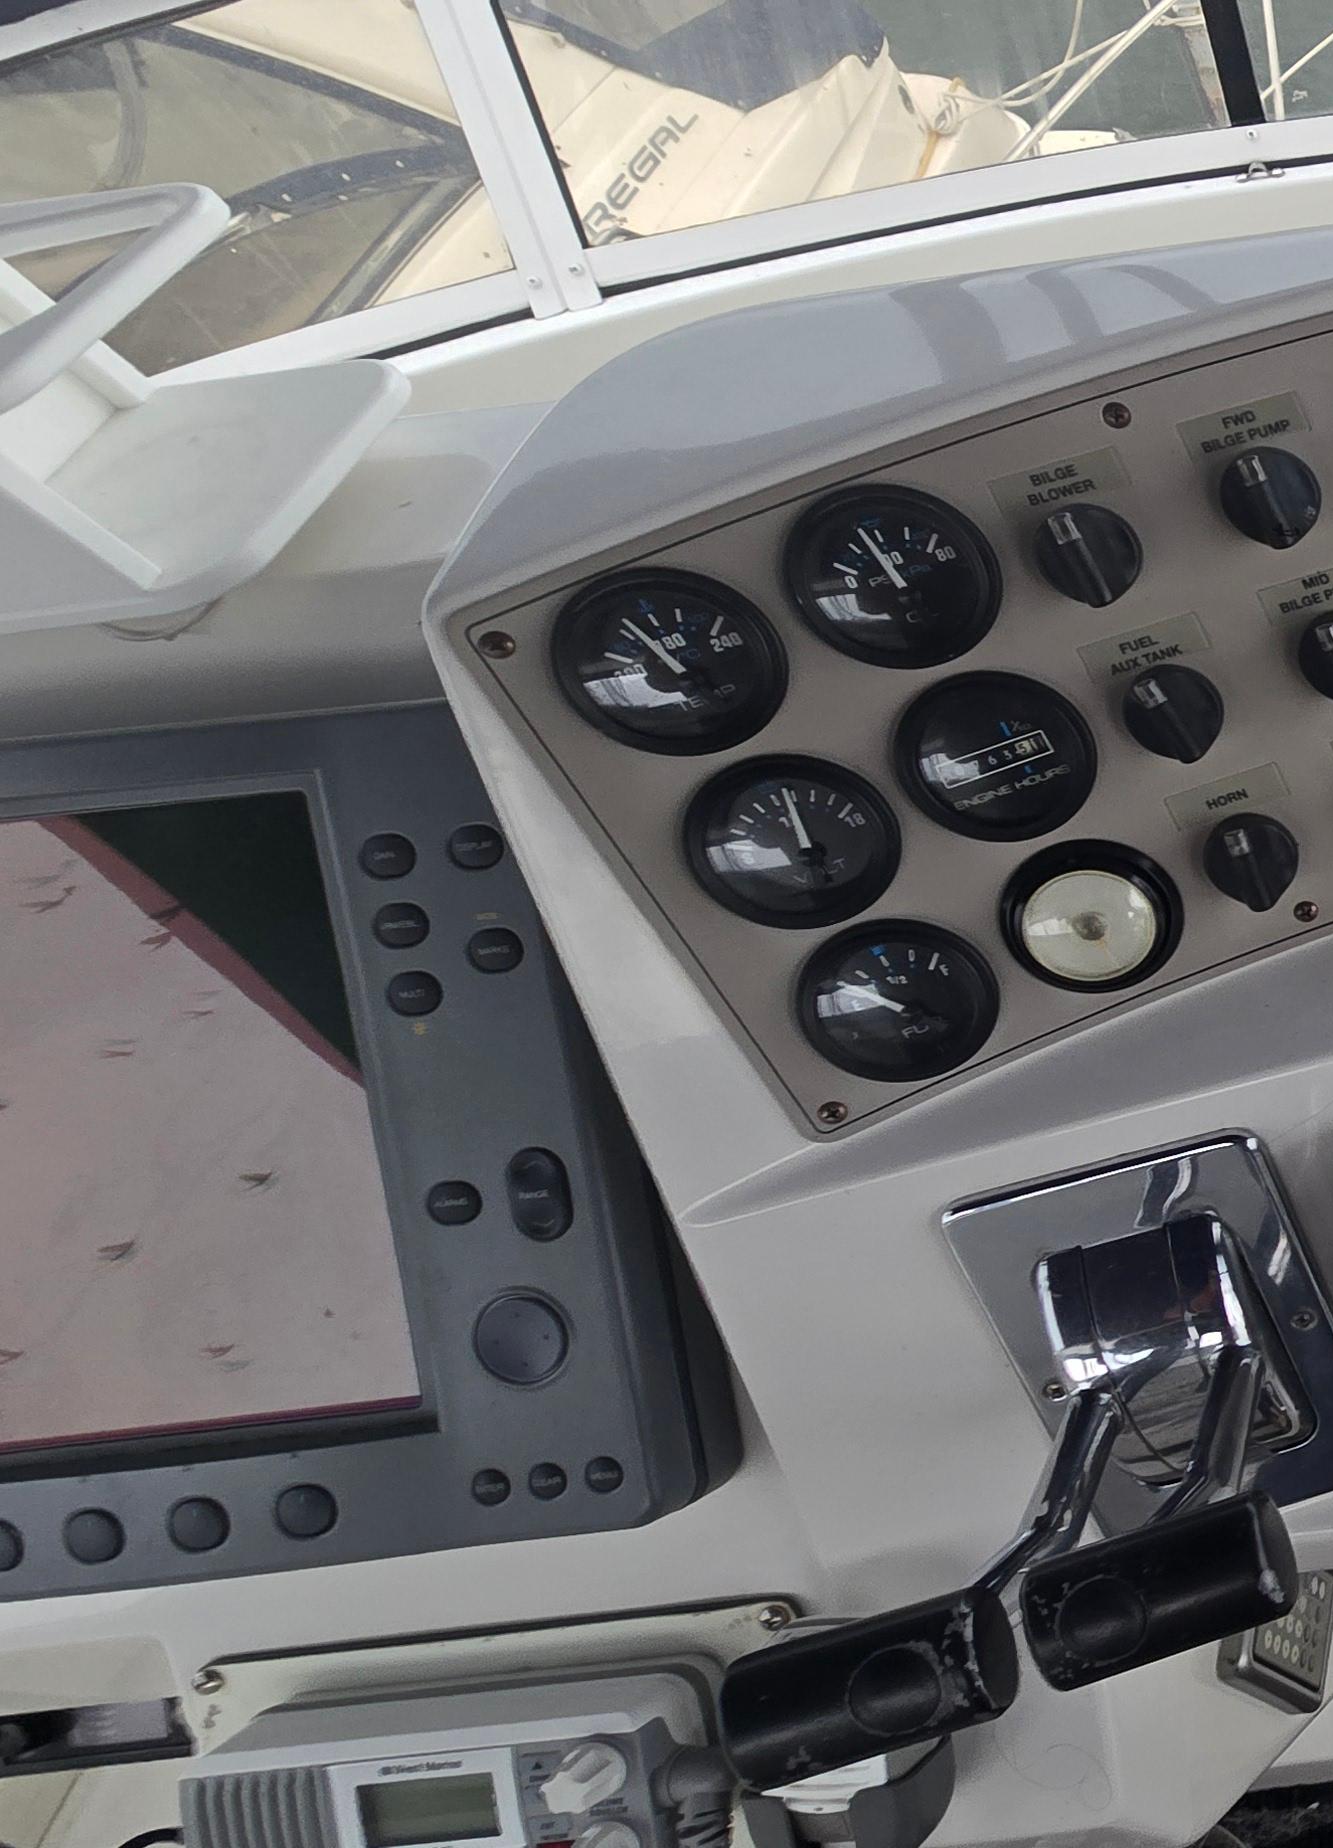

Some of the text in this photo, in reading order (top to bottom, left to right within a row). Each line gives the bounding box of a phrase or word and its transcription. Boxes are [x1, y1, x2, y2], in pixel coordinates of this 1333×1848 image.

[582, 113, 699, 238] REGAL
[1221, 410, 1257, 430] FWD
[1201, 419, 1291, 454] BILGE PUMP
[1029, 463, 1078, 487] BILGE
[1027, 479, 1096, 506] BLOWER
[884, 551, 904, 565] 0
[934, 546, 957, 562] 80
[844, 575, 858, 589] 0
[868, 574, 892, 587] PS
[1302, 573, 1329, 591] MID
[1279, 592, 1322, 615] BILGE
[710, 632, 743, 652] 240
[1118, 635, 1159, 655] FUEL
[1111, 644, 1183, 676] AUX TANK
[674, 683, 736, 711] TEP
[953, 764, 1071, 811] ENGINE HOURS
[1206, 789, 1248, 810] HORN
[844, 812, 866, 828] 18
[793, 858, 844, 884] VLT
